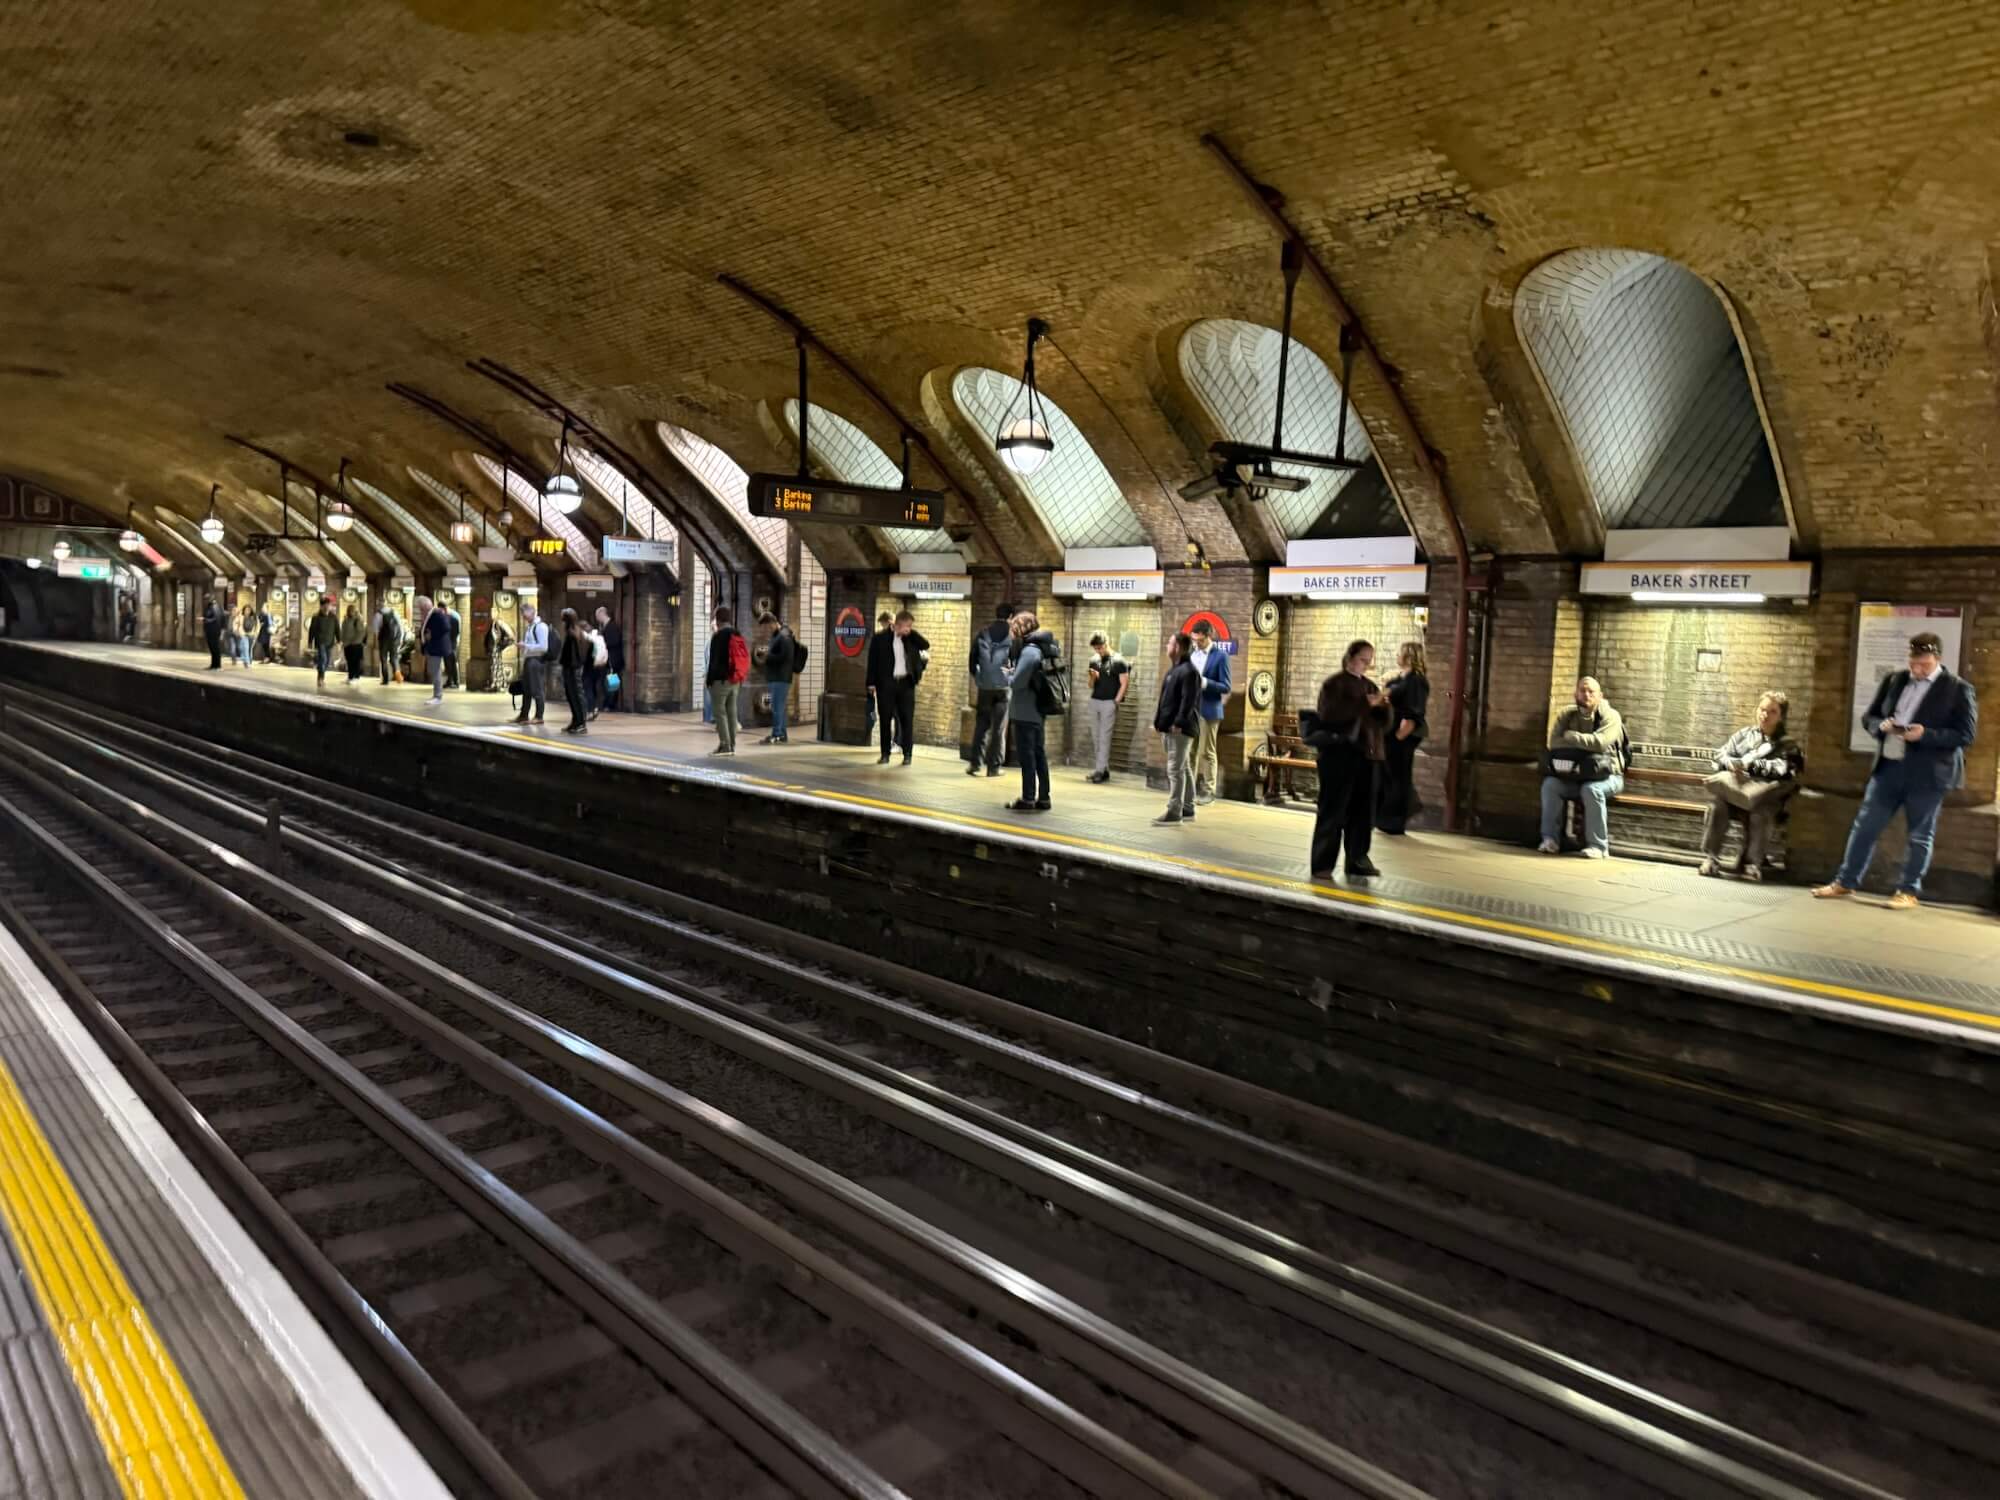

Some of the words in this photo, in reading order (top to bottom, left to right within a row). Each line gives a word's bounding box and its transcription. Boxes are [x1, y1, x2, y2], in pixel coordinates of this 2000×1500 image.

[784, 488, 812, 502] Barking
[783, 498, 811, 512] Barking
[908, 581, 928, 590] BAKER
[930, 581, 953, 591] STREET
[1076, 579, 1103, 590] BAKER
[1105, 579, 1136, 590] STREET
[1303, 576, 1340, 588] BAKER
[1343, 576, 1387, 588] STREET
[1631, 574, 1683, 588] BAKER
[1689, 574, 1752, 589] STREET
[1641, 745, 1673, 756] BAKER
